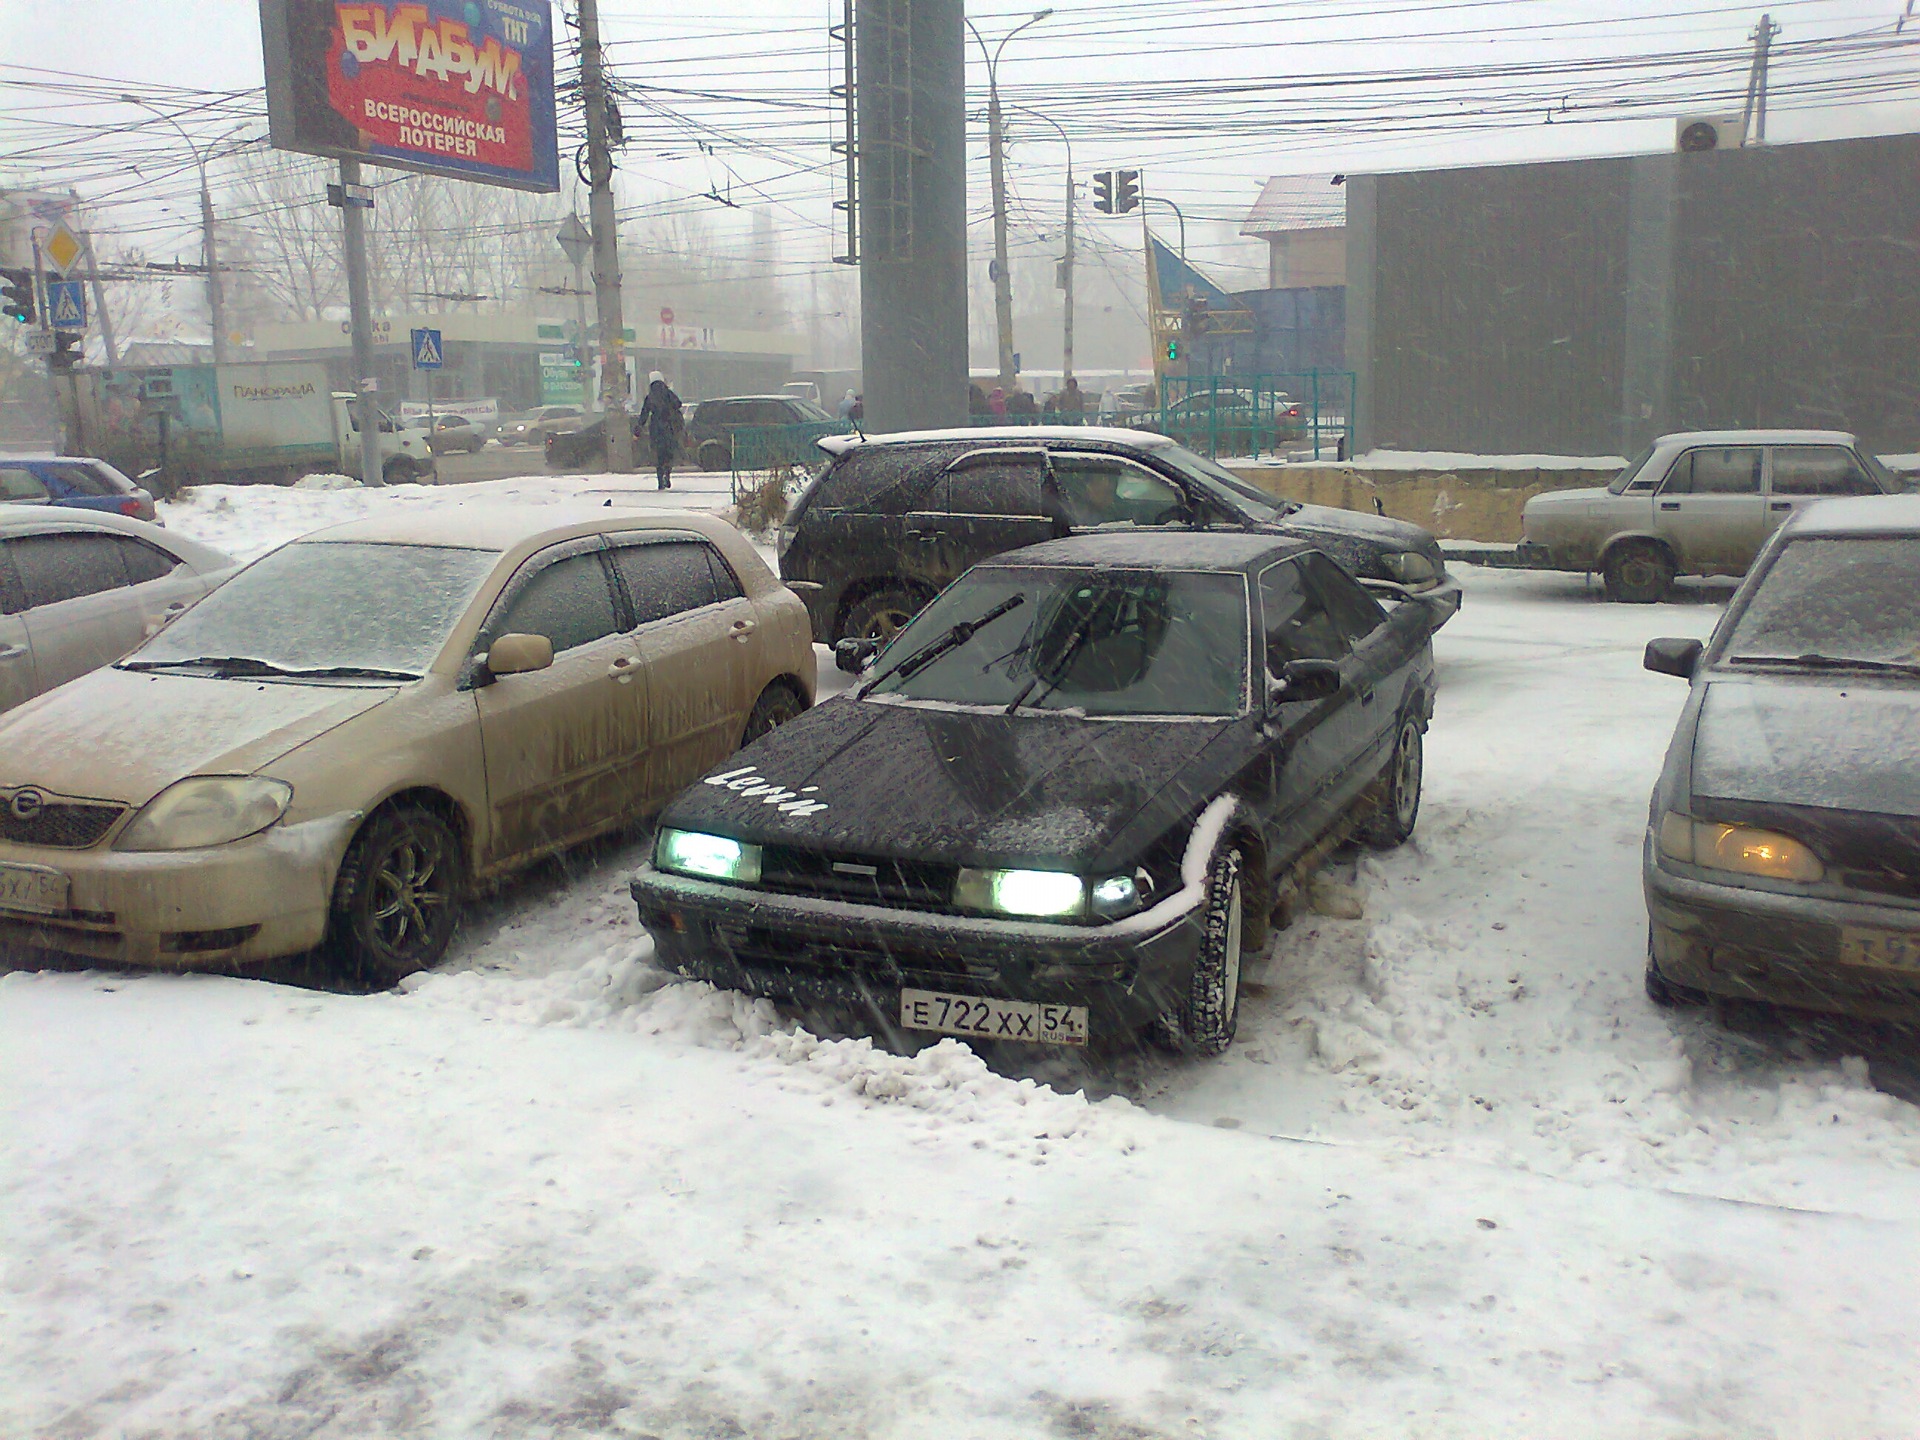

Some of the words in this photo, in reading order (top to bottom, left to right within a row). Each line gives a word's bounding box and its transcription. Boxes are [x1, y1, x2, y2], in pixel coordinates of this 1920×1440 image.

[502, 16, 529, 46] ТНТ
[364, 98, 506, 144] ВСЕРОССИЙСКАЯ
[400, 125, 477, 157] ЛОТЕРЕЯ
[234, 383, 315, 398] ПАНОРАМА
[1043, 1007, 1075, 1032] 54
[1041, 1030, 1065, 1042] RUS
